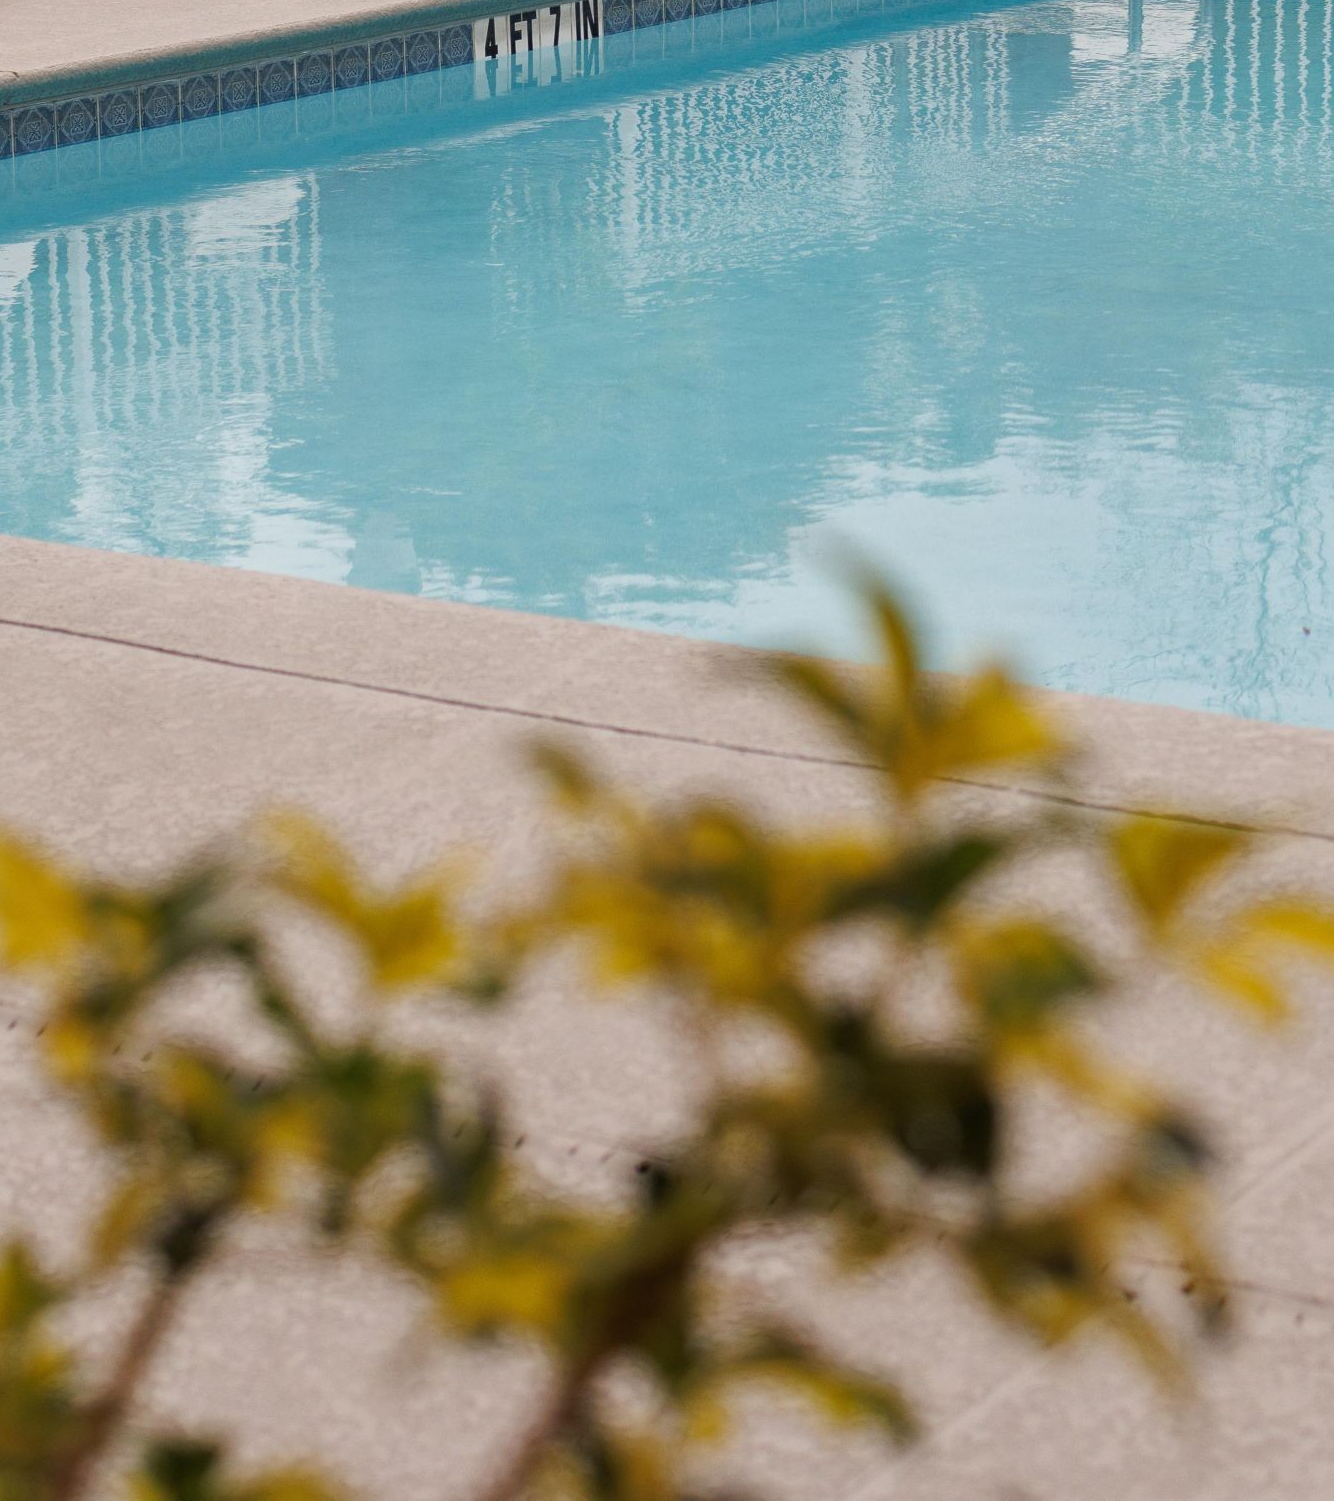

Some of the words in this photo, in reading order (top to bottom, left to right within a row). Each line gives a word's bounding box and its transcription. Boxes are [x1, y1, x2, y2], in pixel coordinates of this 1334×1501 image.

[485, 16, 498, 59] 4
[510, 9, 537, 54] FT
[549, 5, 561, 47] 7
